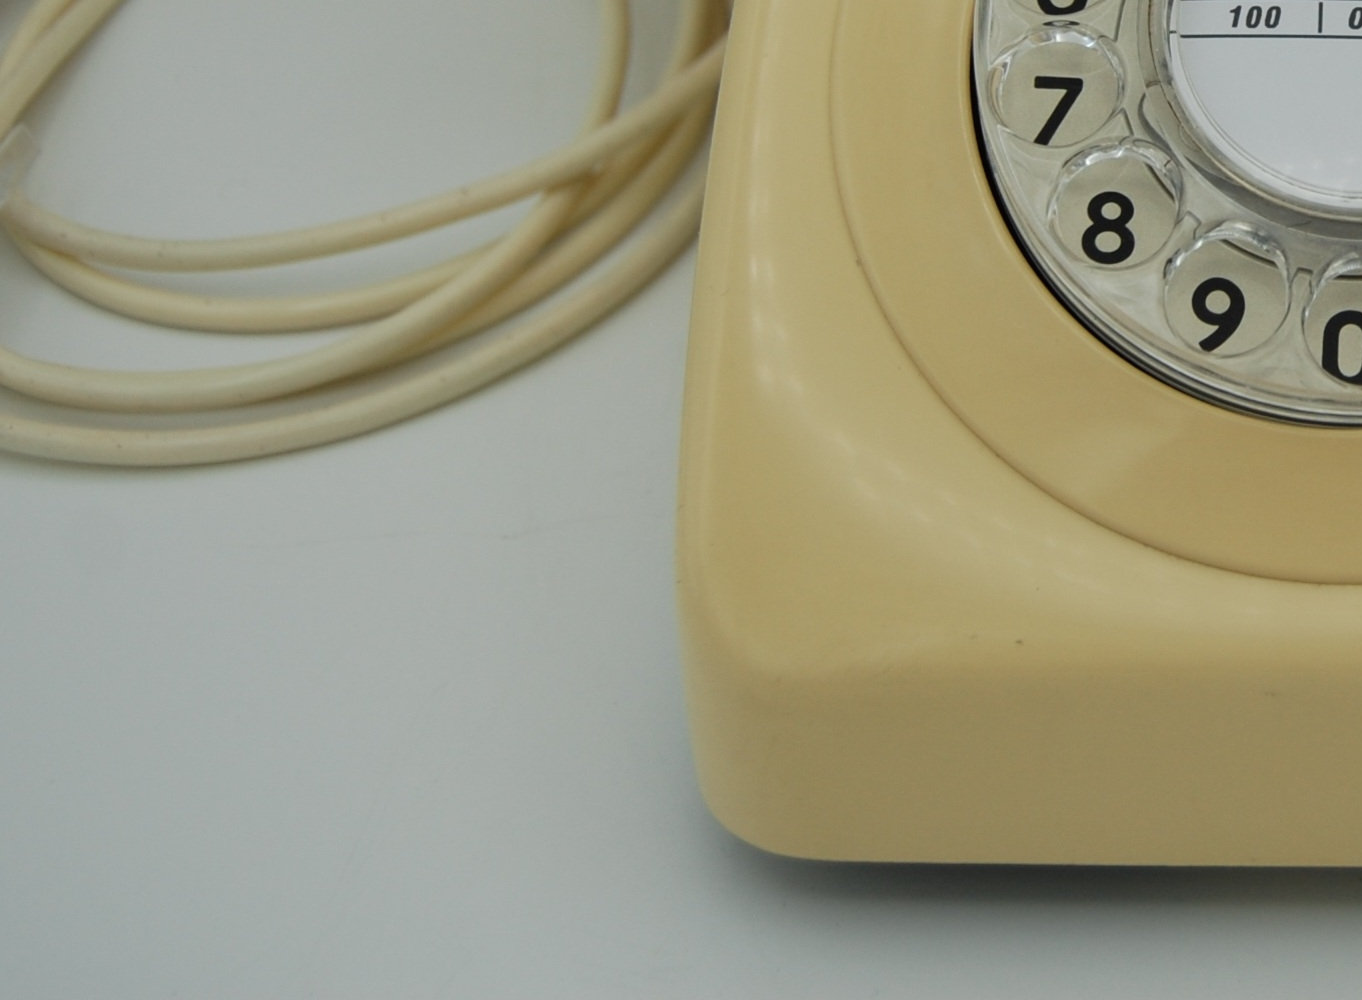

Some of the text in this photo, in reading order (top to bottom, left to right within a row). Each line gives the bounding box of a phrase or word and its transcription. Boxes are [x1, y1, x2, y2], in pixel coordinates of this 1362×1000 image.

[1229, 5, 1282, 29] 100
[1034, 75, 1084, 146] 7
[1081, 191, 1135, 265] 8
[1191, 277, 1246, 352] 9
